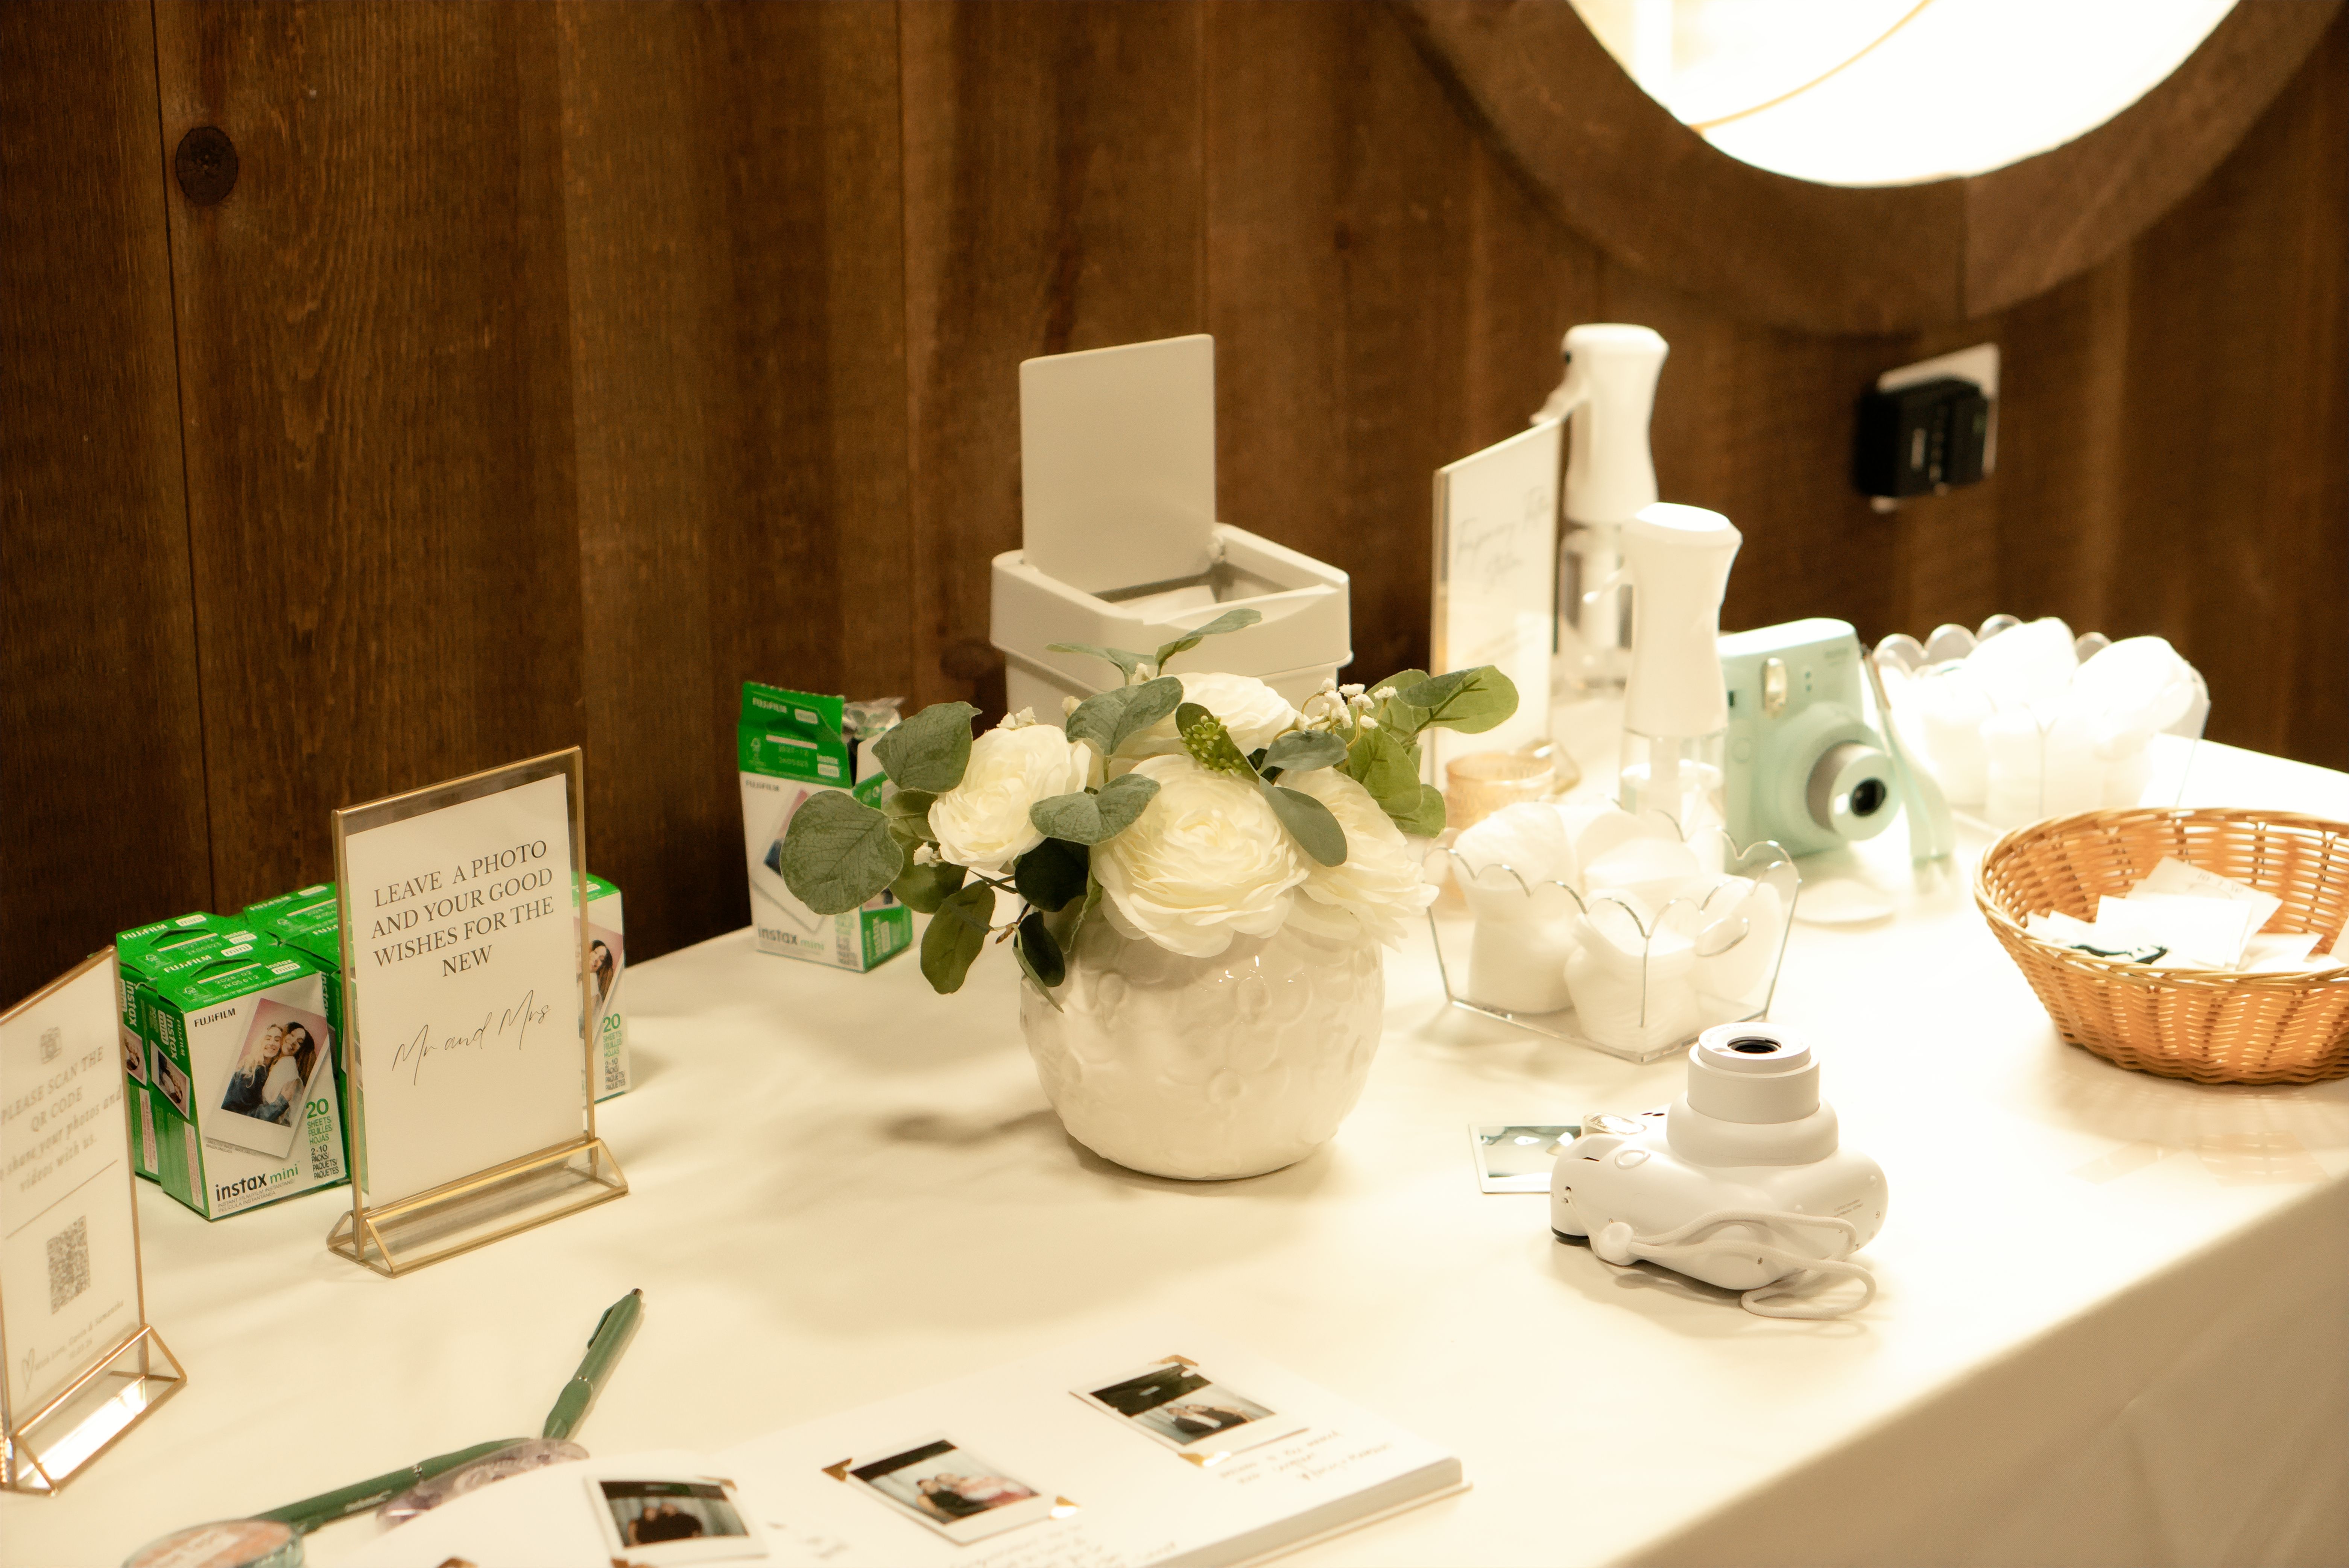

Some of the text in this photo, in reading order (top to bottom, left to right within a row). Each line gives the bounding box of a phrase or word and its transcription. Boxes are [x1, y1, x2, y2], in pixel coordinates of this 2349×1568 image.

[374, 840, 547, 907] LEAVE A PHOTO
[371, 909, 418, 939] AND
[423, 889, 485, 922] YOUR
[489, 868, 552, 901] GOOD
[122, 915, 203, 940] FUJIFILM mini
[373, 896, 554, 967] WISHES FOR THE
[758, 922, 798, 945] instax
[163, 945, 250, 973] FUJIFILM mini
[266, 959, 293, 969] instax
[276, 963, 298, 974] mini
[442, 944, 492, 977] NEW
[126, 981, 137, 1027] instax
[194, 1008, 236, 1028] FUJIFILM
[166, 1013, 178, 1061] instax
[177, 1019, 185, 1056] FUJIFILM
[392, 990, 551, 1086] Mr and Mrs
[603, 1013, 620, 1033] 20
[0, 1045, 104, 1125] PLEASE SCAN THE
[30, 1085, 84, 1133] QR CODE
[38, 1128, 63, 1160] your
[65, 1103, 100, 1141] photos
[102, 1083, 122, 1110] and
[305, 1098, 329, 1119] 20
[309, 1133, 329, 1145] HOJAS
[19, 1162, 53, 1193] videos
[56, 1140, 81, 1167] with
[82, 1133, 98, 1150] us.
[314, 1166, 339, 1180] PAQUETES
[215, 1163, 298, 1201] instax mini
[217, 1197, 238, 1208] INSTANT
